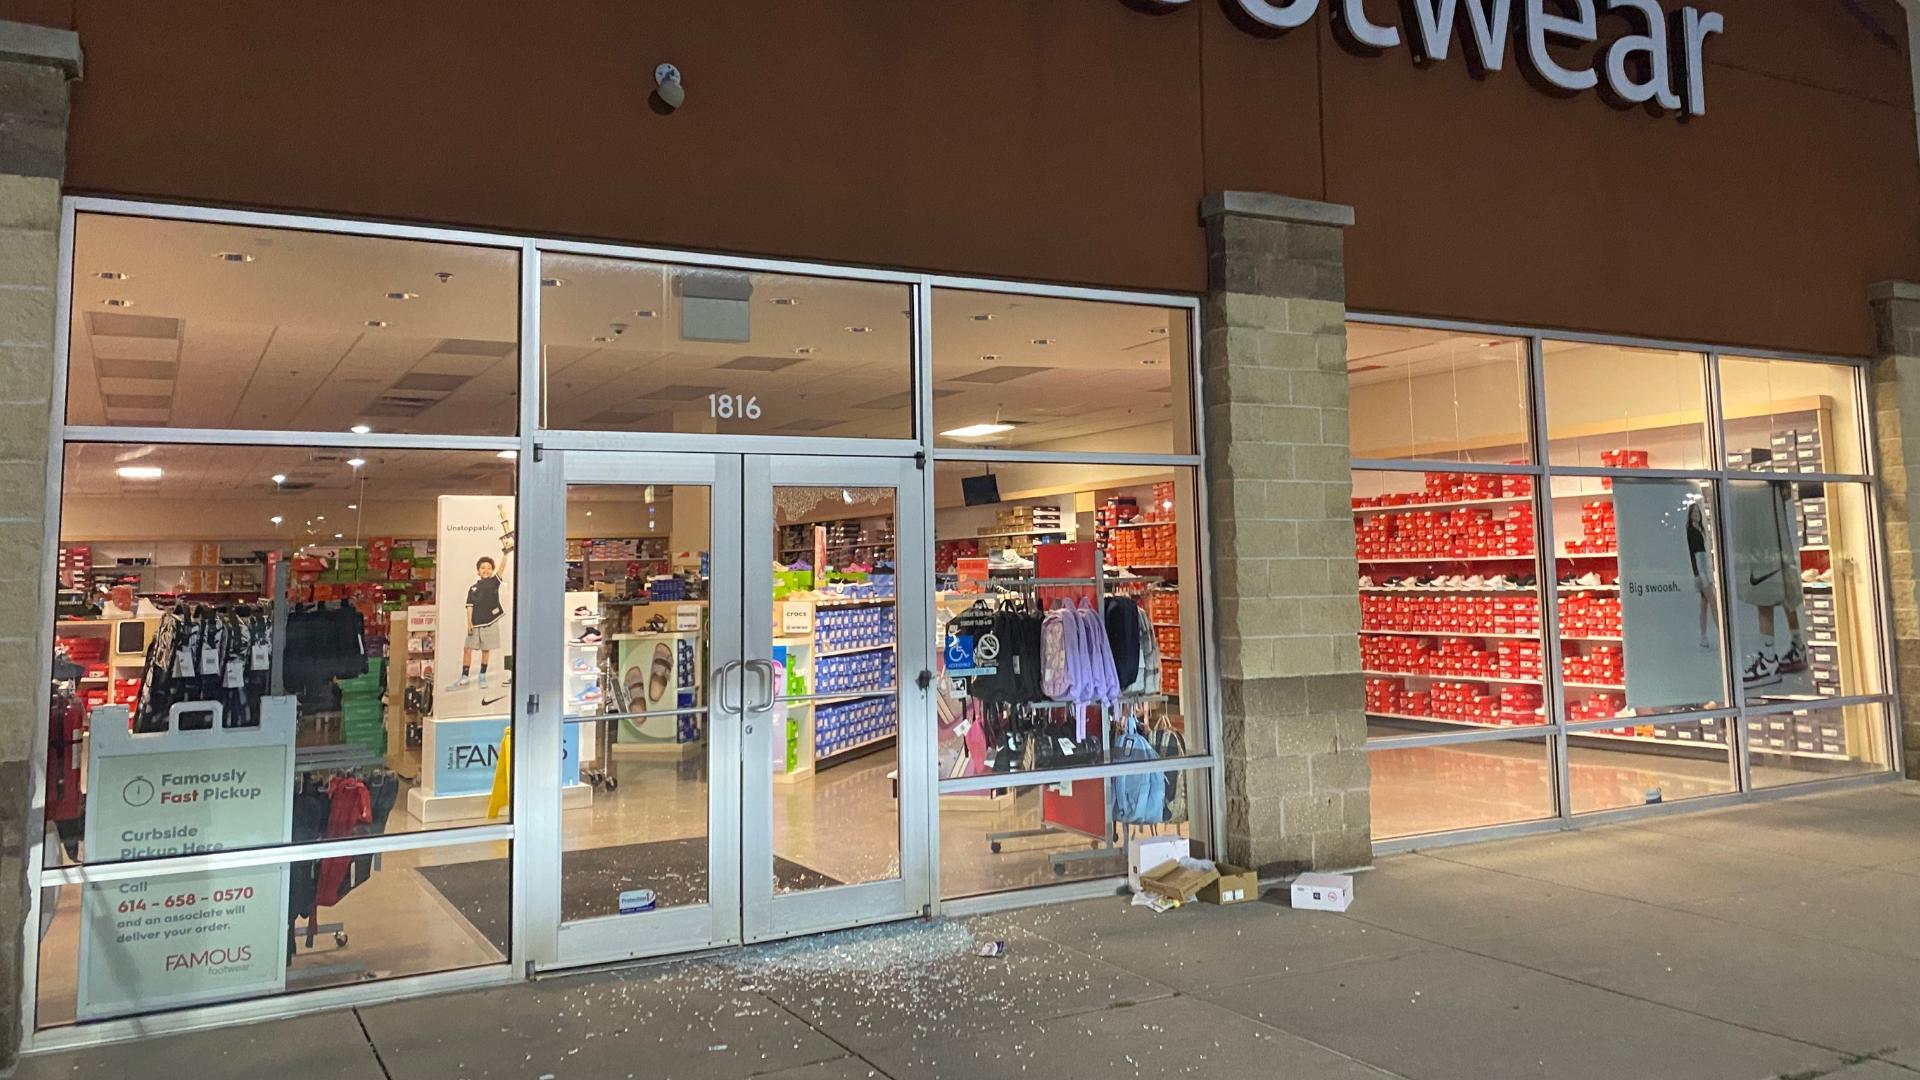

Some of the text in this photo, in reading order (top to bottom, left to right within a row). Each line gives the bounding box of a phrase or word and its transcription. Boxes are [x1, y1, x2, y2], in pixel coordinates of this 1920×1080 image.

[1130, 0, 1724, 116] wear
[708, 393, 761, 420] 1816
[446, 524, 496, 533] Unstoppable.
[1629, 580, 1681, 596] Big swoosh.
[162, 769, 246, 787] Famously
[160, 786, 262, 804] Fast Pickup
[121, 825, 198, 842] Curbside
[119, 881, 148, 894] Call
[118, 899, 146, 913] 614
[165, 893, 196, 908] 658
[213, 887, 254, 902] 0570
[117, 905, 246, 928] and an associate will
[116, 922, 231, 944] deliver your order.
[165, 945, 252, 972] FAMOUS
[208, 964, 251, 976] footwear
